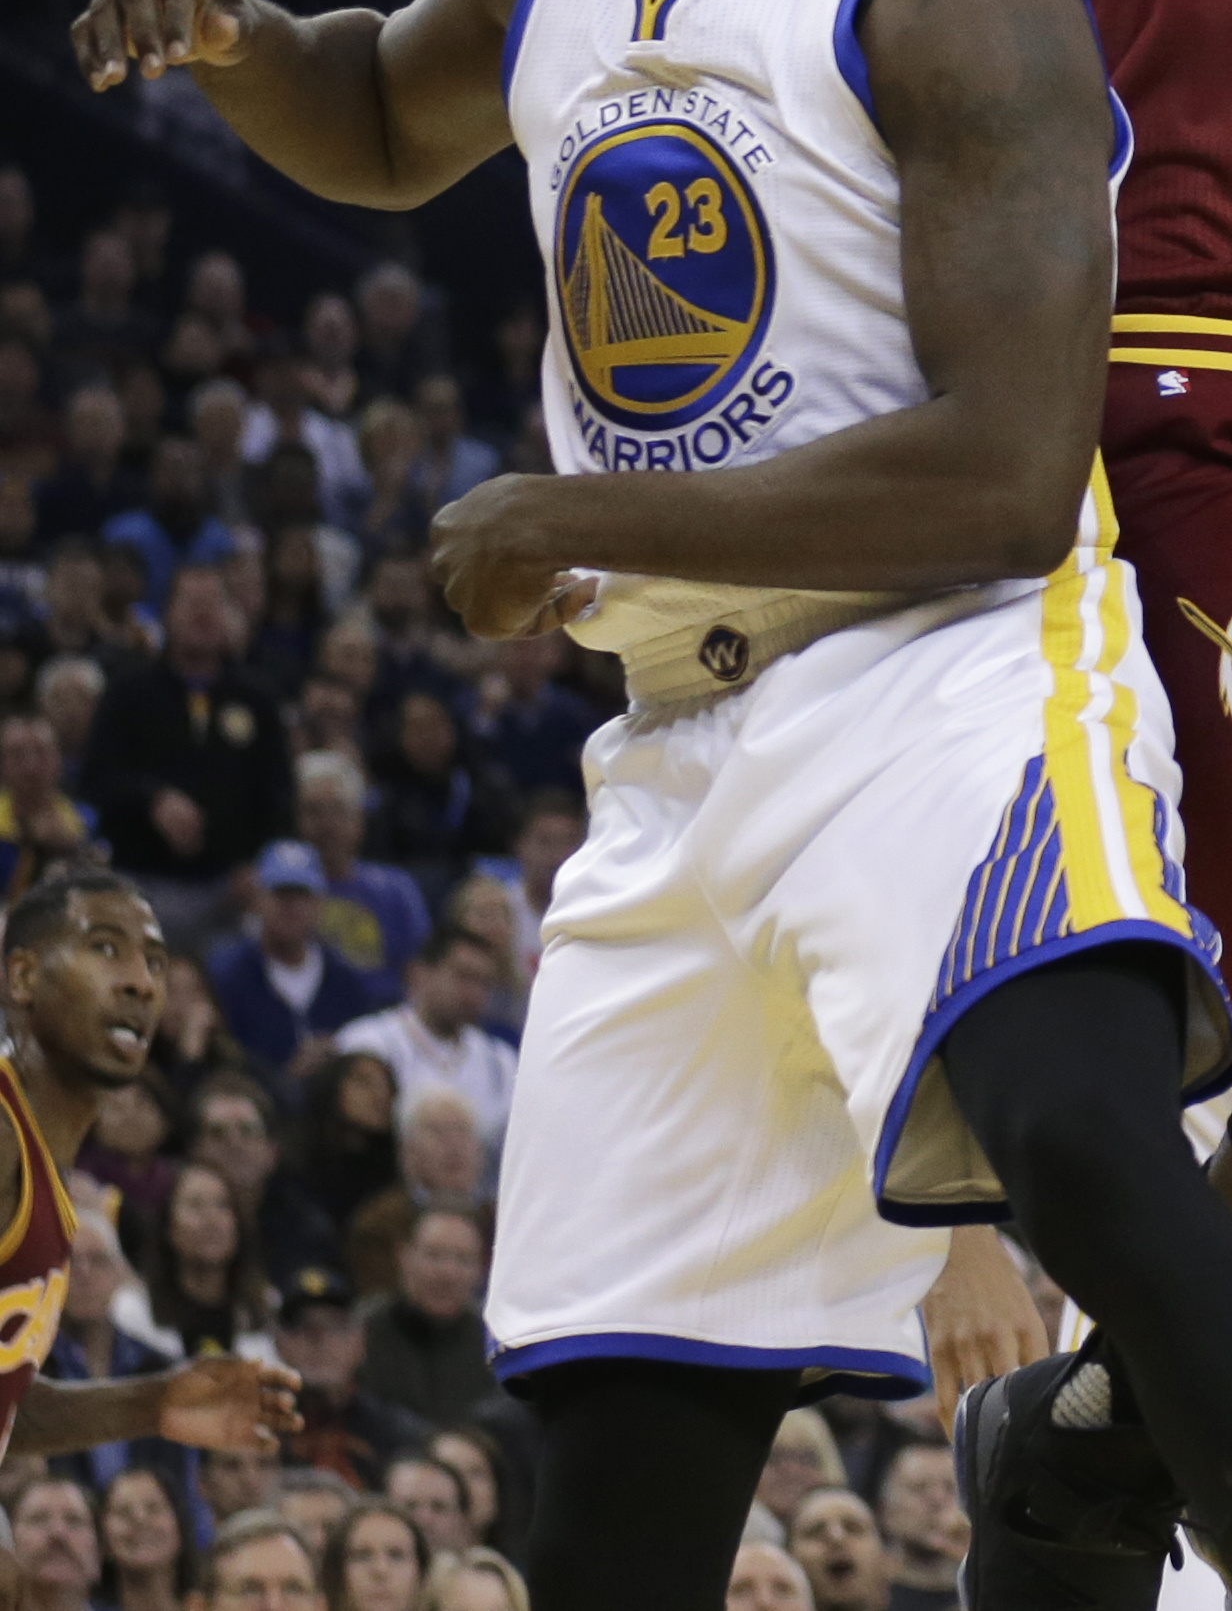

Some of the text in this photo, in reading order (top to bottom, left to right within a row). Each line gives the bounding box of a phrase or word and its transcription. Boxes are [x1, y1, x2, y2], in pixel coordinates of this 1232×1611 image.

[551, 89, 774, 191] GOLDEN STATE
[644, 177, 728, 260] 23
